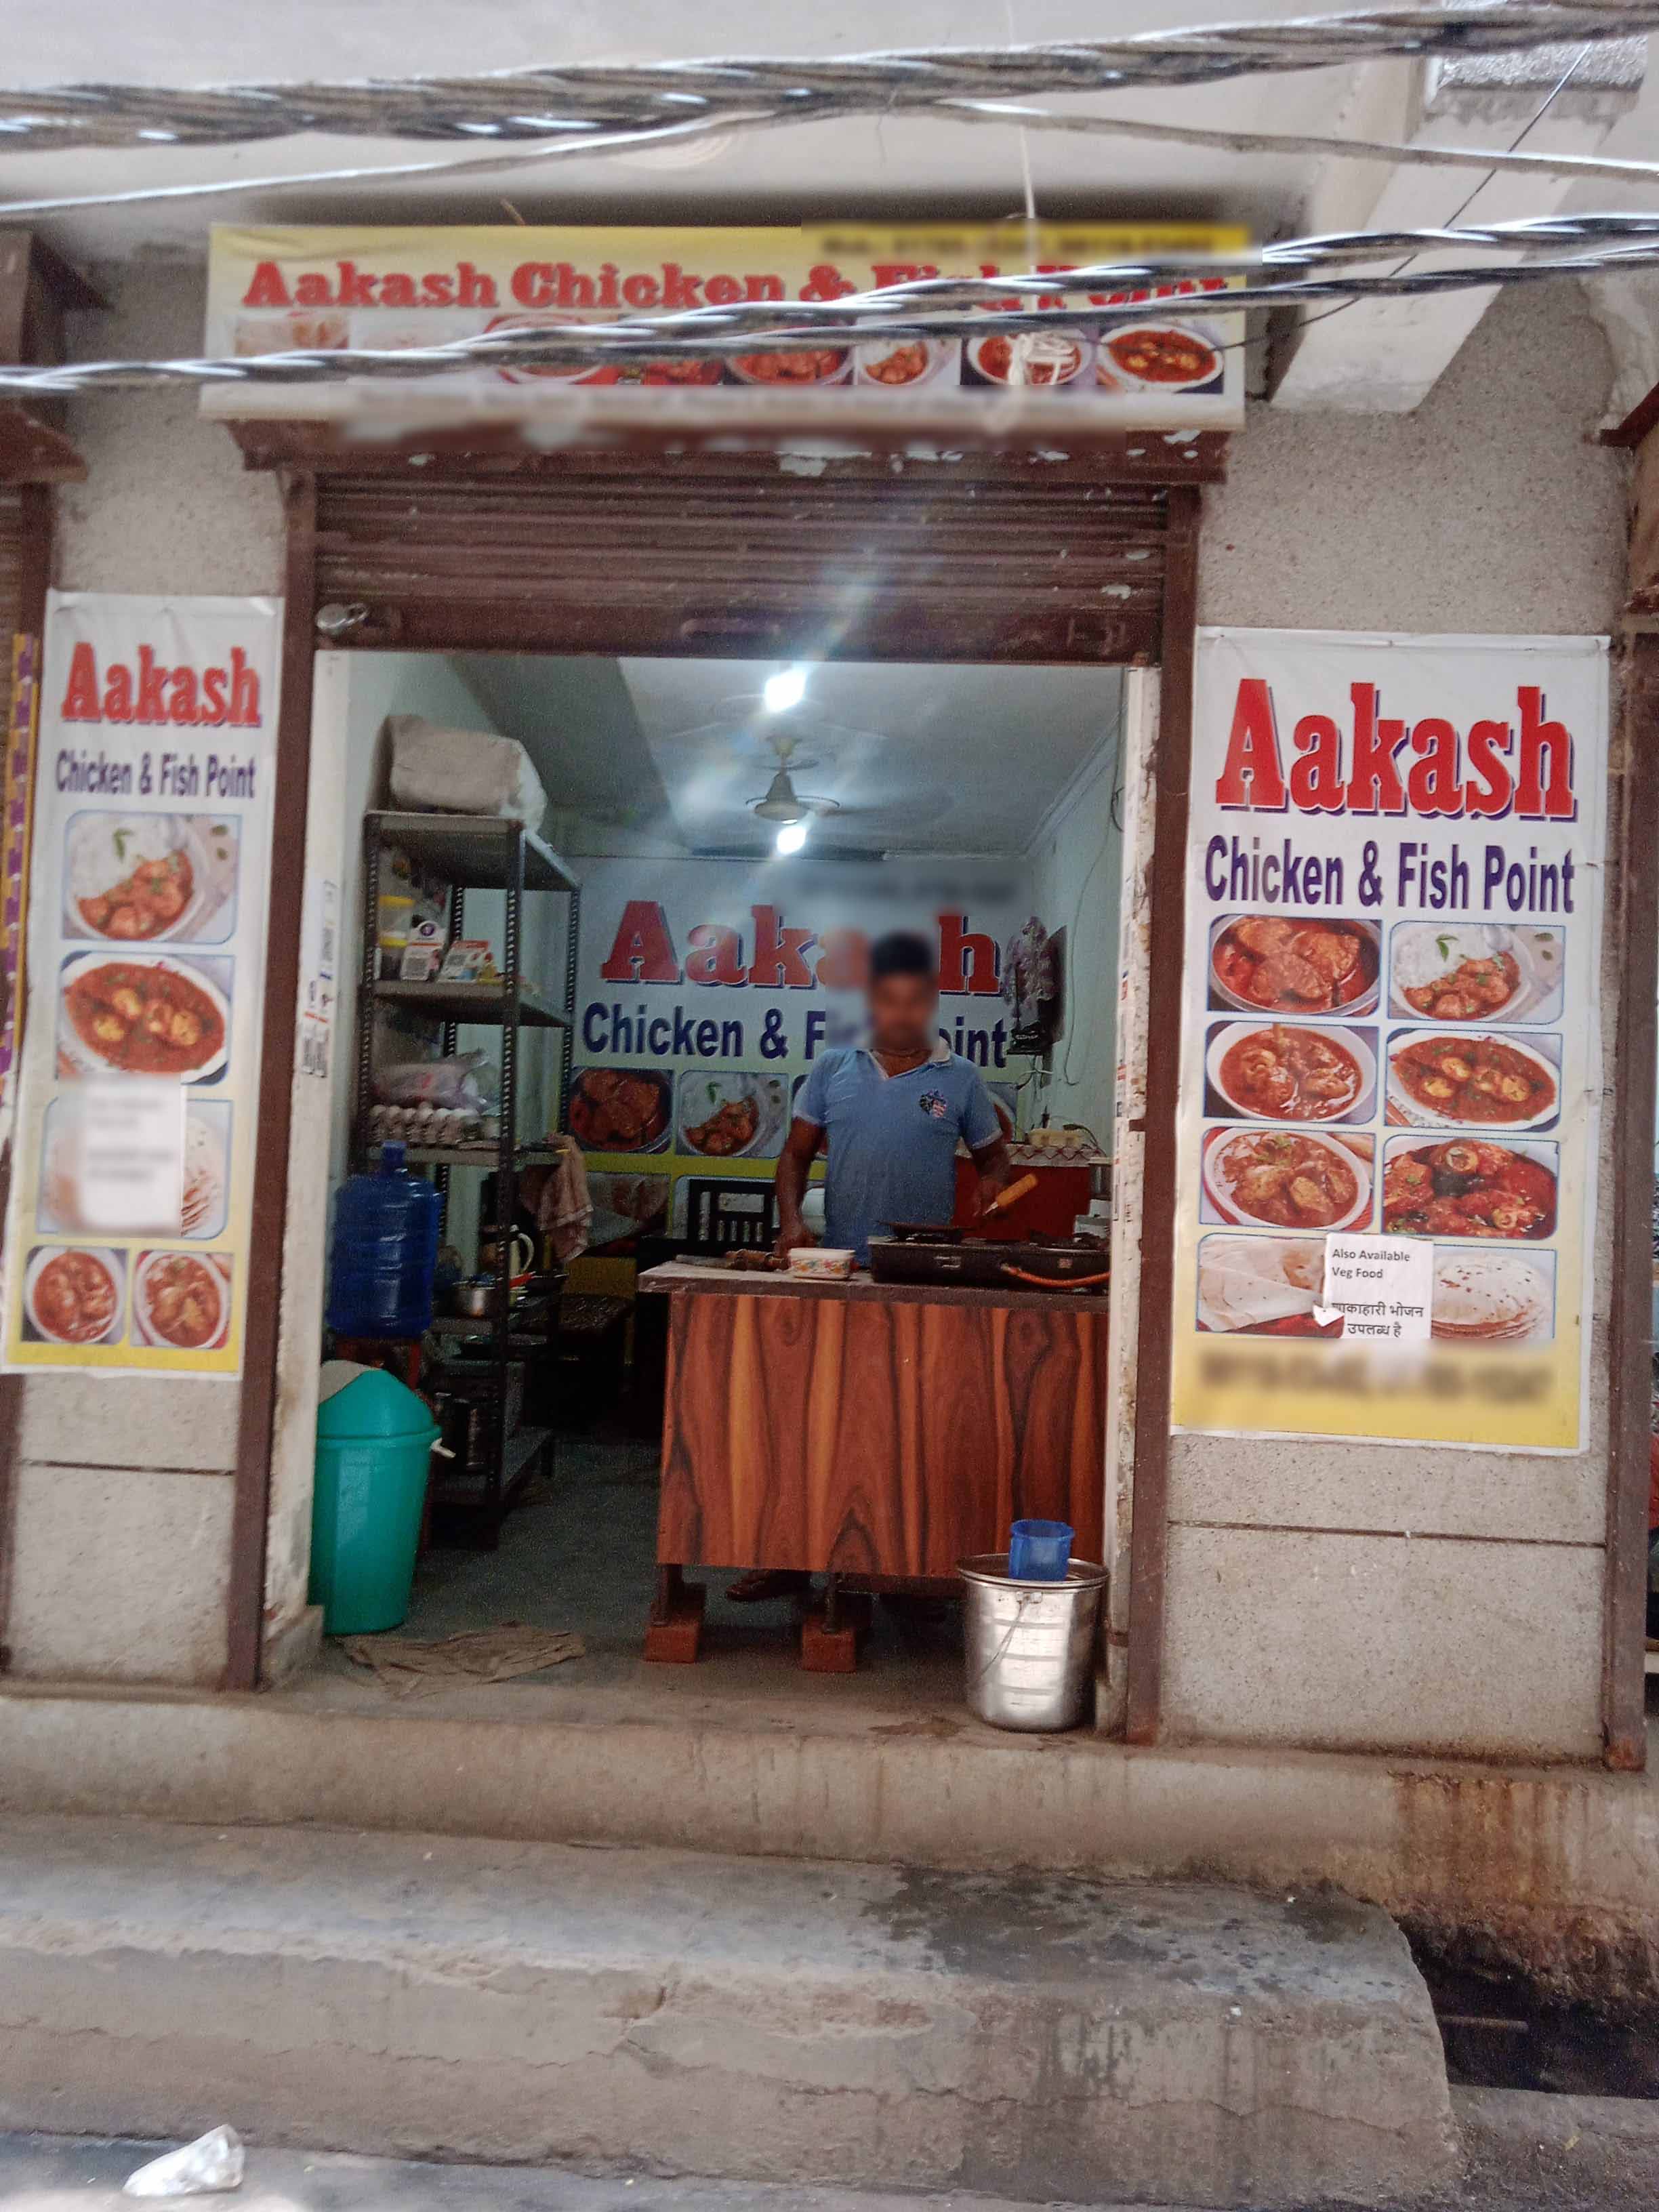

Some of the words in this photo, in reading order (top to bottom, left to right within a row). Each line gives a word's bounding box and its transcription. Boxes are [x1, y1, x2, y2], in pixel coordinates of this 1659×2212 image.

[242, 261, 498, 308] Aakash
[511, 261, 785, 308] Chicken
[799, 265, 857, 302] &
[62, 641, 262, 727] Aakash
[56, 748, 131, 794] Chicken
[139, 752, 152, 795] &
[159, 752, 199, 797] Fish
[206, 754, 255, 799] Point
[1215, 678, 1578, 822] Aakash
[1205, 835, 1344, 905] Chicken
[1359, 840, 1382, 907] &
[1398, 842, 1469, 909] Fish
[1483, 845, 1575, 914] Point
[583, 1002, 744, 1057] Chicken
[760, 1008, 789, 1059] &
[1332, 1249, 1356, 1259] Also
[1359, 1250, 1410, 1262] Available
[1332, 1267, 1353, 1279] Veg
[1356, 1269, 1383, 1279] Food
[1390, 1302, 1425, 1317] भोजन
